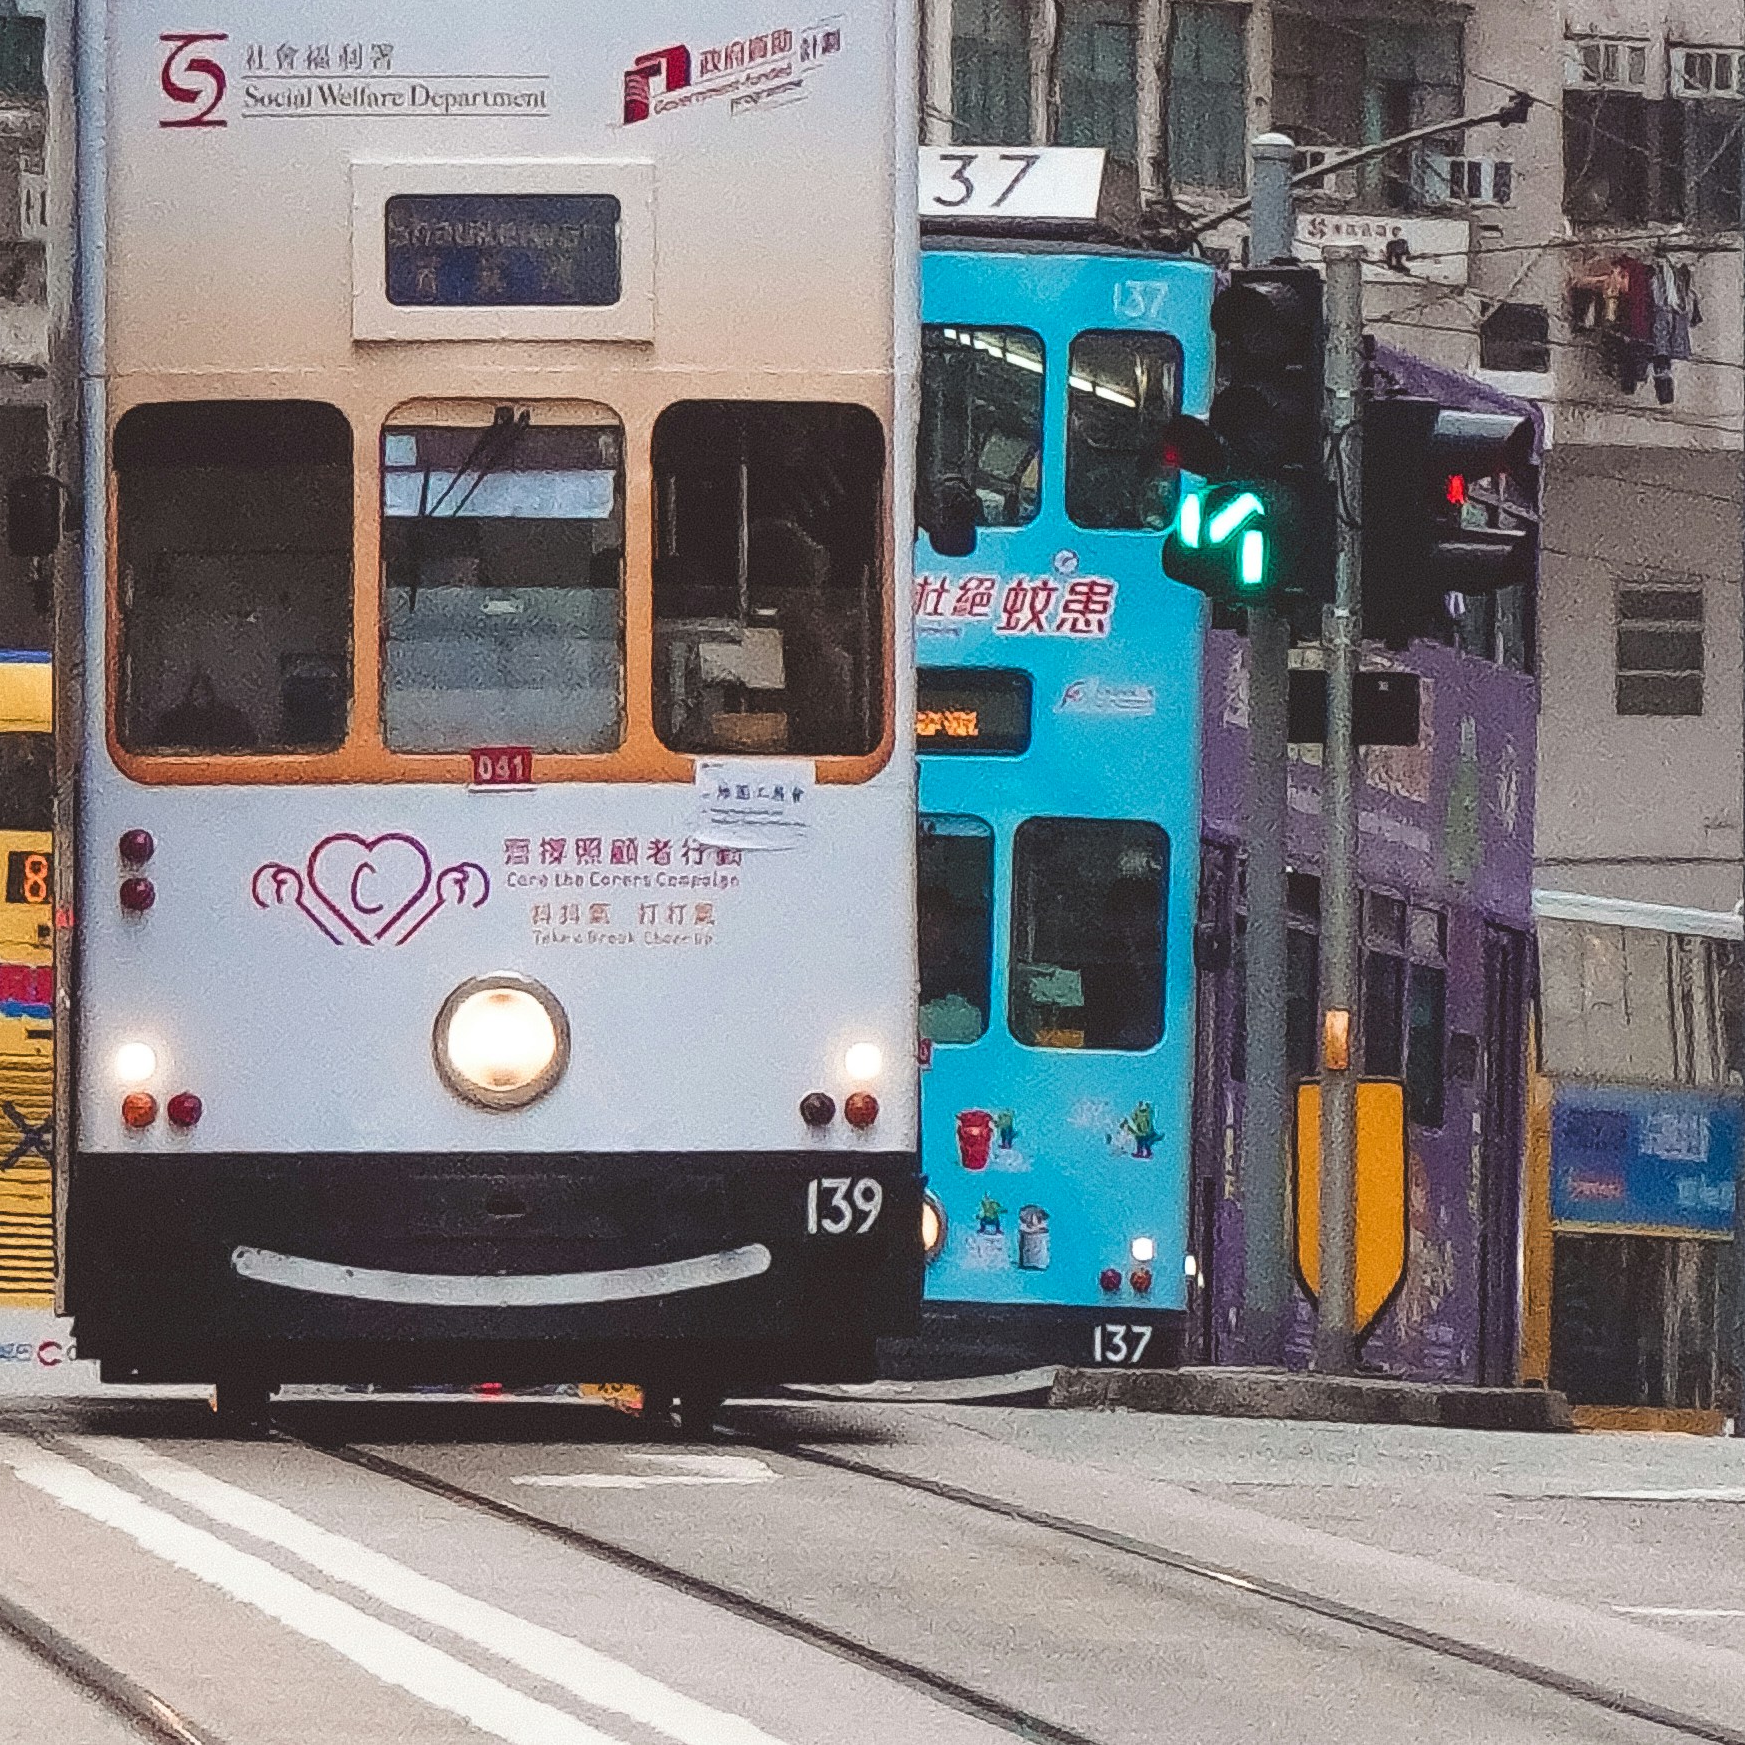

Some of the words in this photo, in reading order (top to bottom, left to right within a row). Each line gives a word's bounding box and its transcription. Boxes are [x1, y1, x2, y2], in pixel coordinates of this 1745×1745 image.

[244, 85, 312, 107] Social
[318, 84, 404, 107] Welfare
[411, 85, 547, 113] Department
[1113, 280, 1168, 317] 137
[915, 575, 1115, 633] 杜絕蚊患
[507, 872, 548, 888] Care
[554, 872, 584, 888] the
[807, 1177, 883, 1235] 139
[1093, 1324, 1153, 1363] 137
